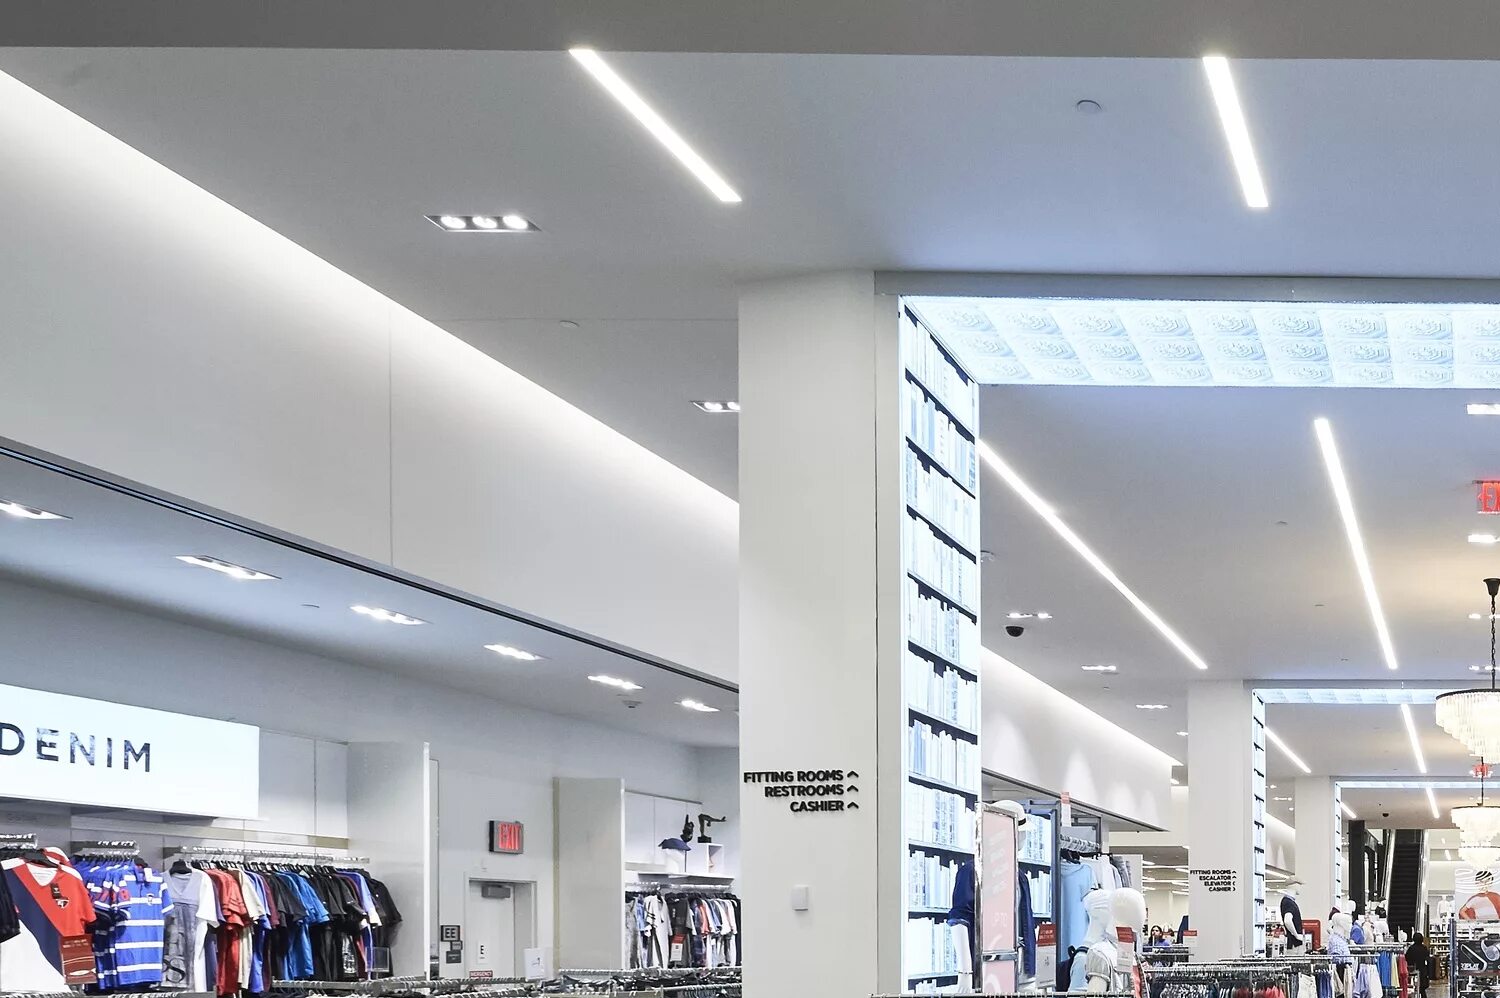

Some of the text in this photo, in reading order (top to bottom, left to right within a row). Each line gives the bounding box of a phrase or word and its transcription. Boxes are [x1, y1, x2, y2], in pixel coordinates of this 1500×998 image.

[0, 722, 151, 773] DENIM
[743, 770, 844, 783] FITTING ROOMS
[764, 784, 845, 797] RESTROOMS
[789, 800, 844, 813] CASHIER
[499, 823, 521, 850] EXIT
[445, 927, 456, 939] EE
